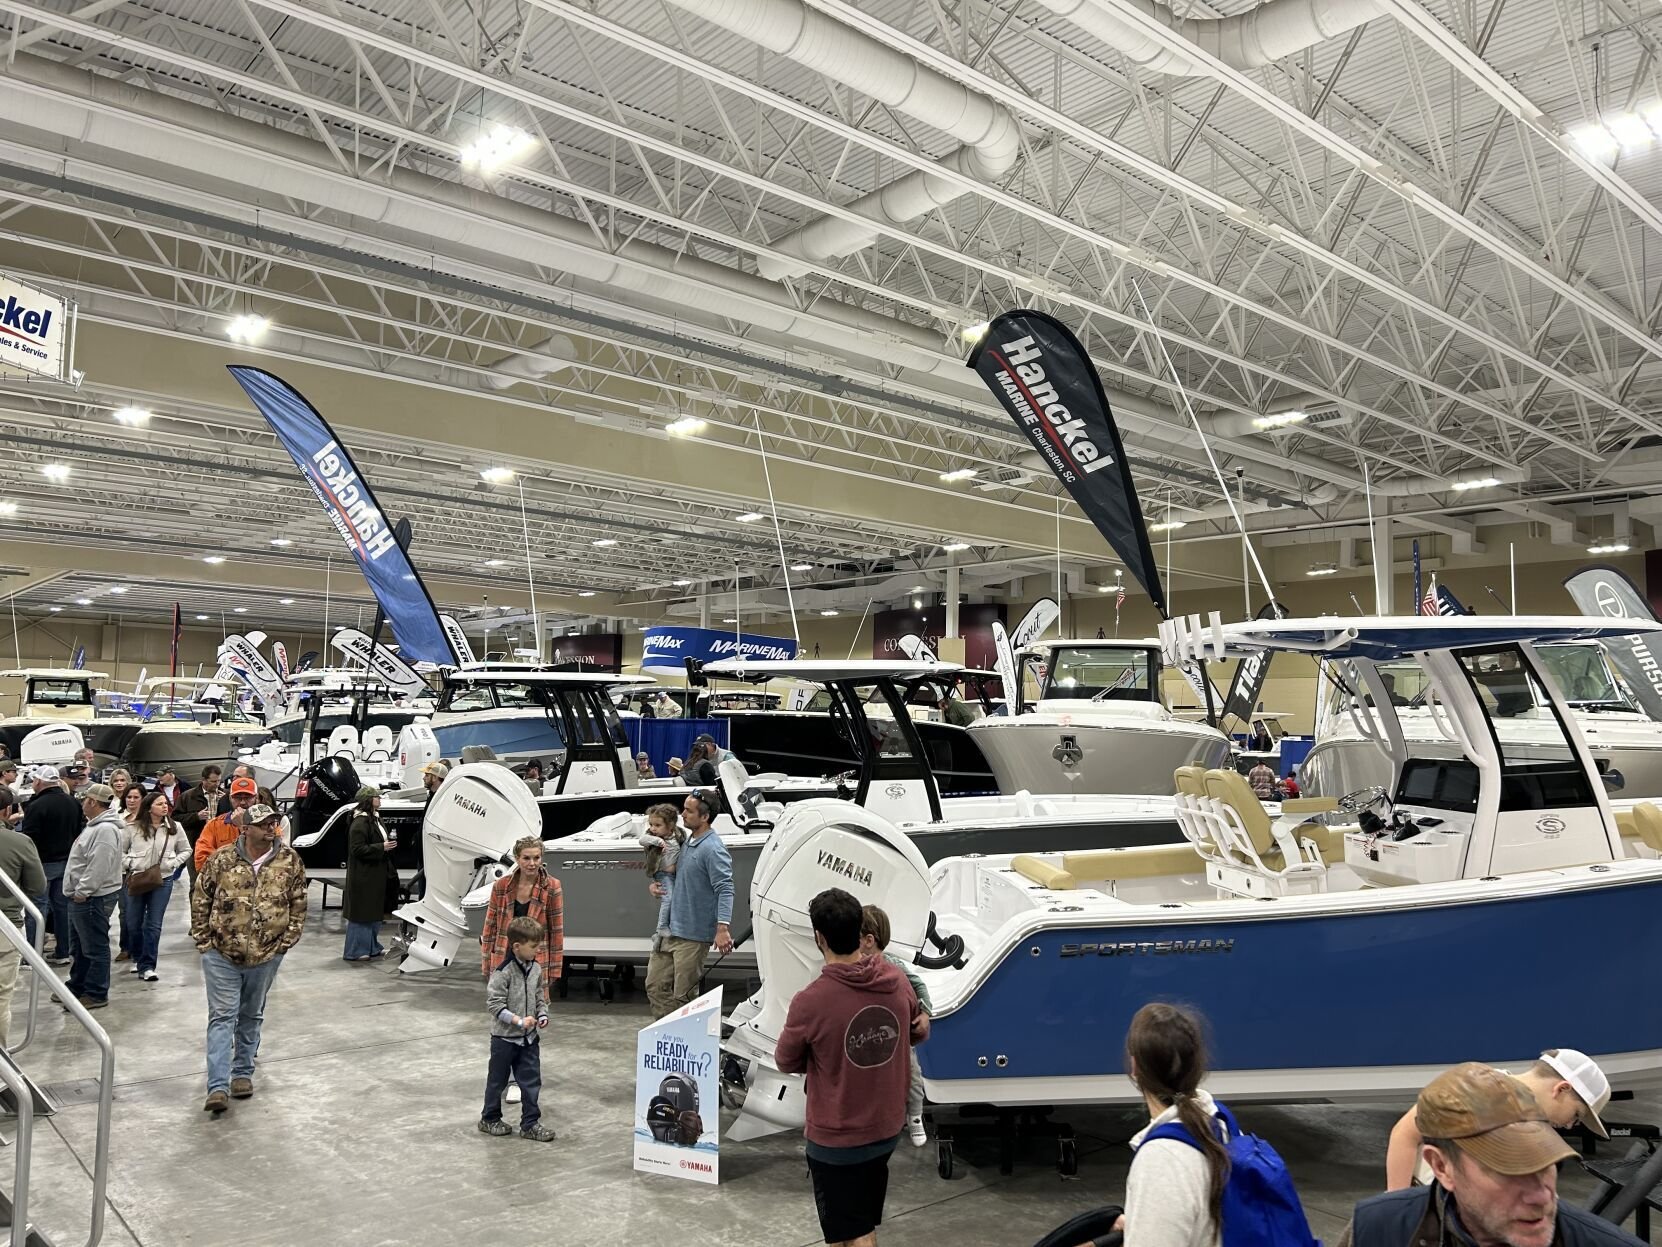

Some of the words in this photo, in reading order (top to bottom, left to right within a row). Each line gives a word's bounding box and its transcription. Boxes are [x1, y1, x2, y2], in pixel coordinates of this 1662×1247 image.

[13, 341, 20, 349] &
[21, 344, 48, 360] Service
[1001, 335, 1115, 474] Hanckel
[994, 369, 1039, 426] MARINE
[1032, 427, 1064, 472] Charleston,
[1062, 469, 1076, 483] SC
[236, 642, 264, 672] WHALER
[447, 626, 469, 663] WHALER
[1624, 633, 1662, 699] PURSU
[313, 776, 340, 801] MERCURY
[453, 793, 487, 818] YAMAHA
[561, 860, 646, 870] SPORTSM
[817, 849, 873, 887] YAMAHA
[1060, 938, 1235, 957] SPORTSMAN
[656, 1041, 689, 1059] READY
[688, 1052, 697, 1060] for
[662, 1033, 671, 1041] Are
[673, 1035, 684, 1043] you
[687, 1161, 712, 1173] YAMAHA
